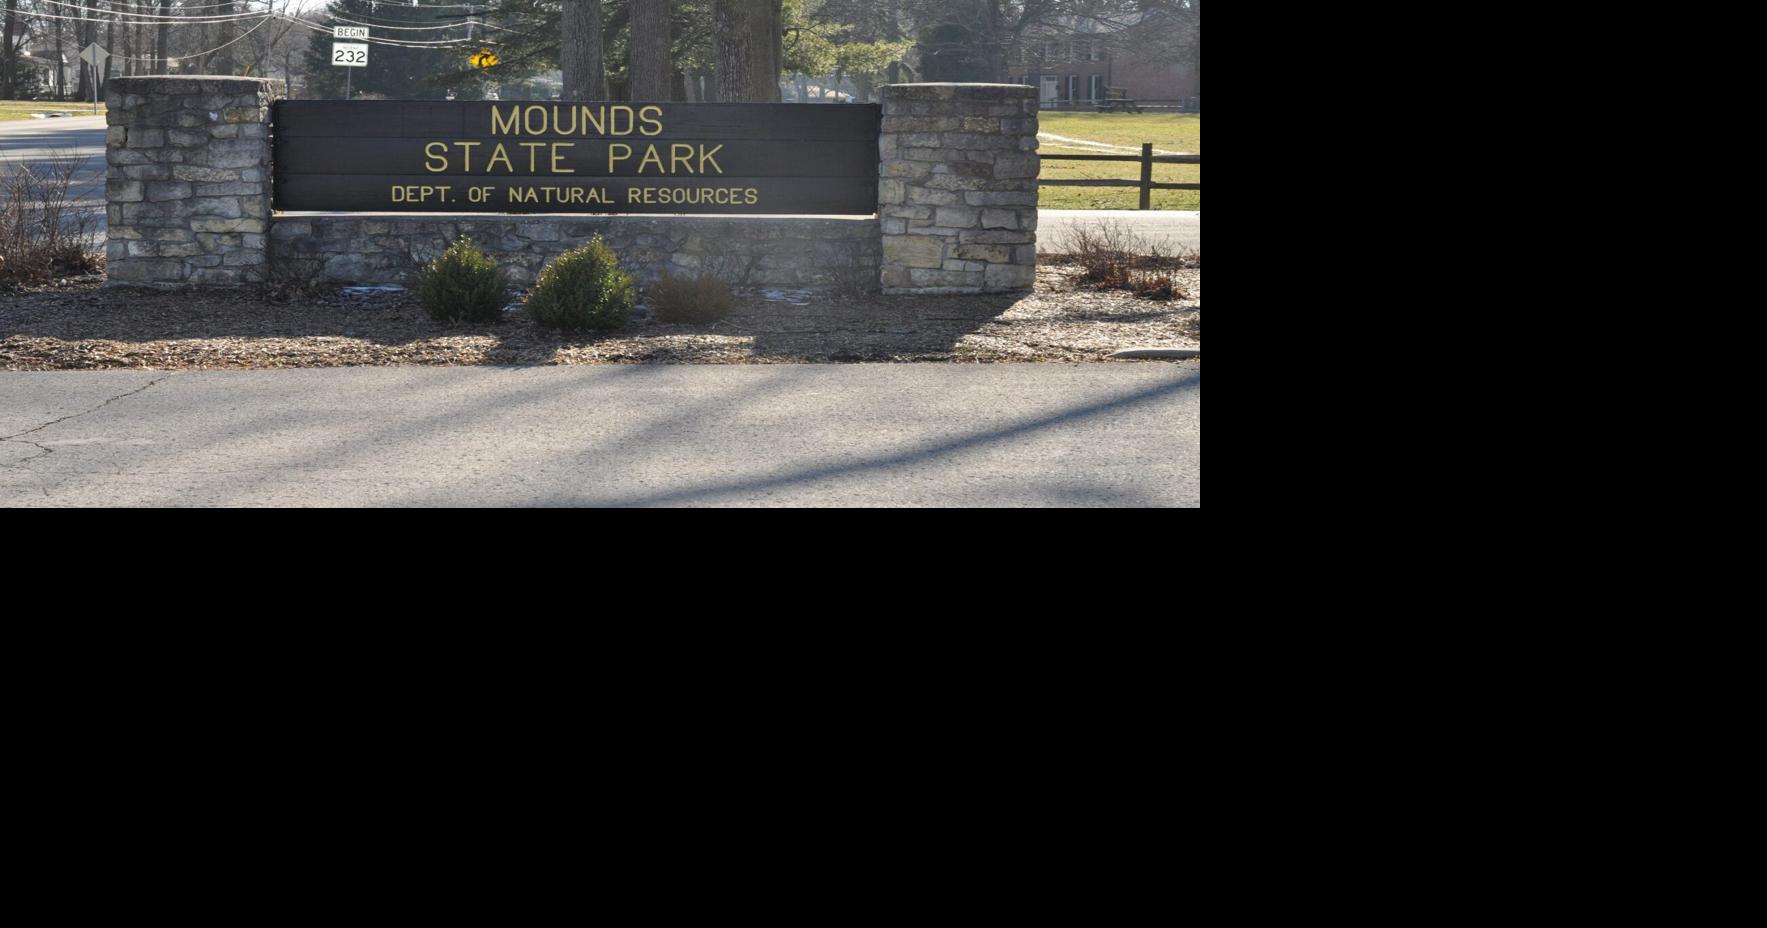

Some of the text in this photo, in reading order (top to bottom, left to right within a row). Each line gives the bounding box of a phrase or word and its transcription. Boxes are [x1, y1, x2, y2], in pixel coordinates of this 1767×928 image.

[336, 27, 366, 37] BEGIN
[334, 49, 366, 63] 232
[491, 105, 663, 136] MOUNDS
[424, 141, 724, 174] STATE PARK
[391, 185, 758, 205] DEPT. OF NATURAL RESOURCES
